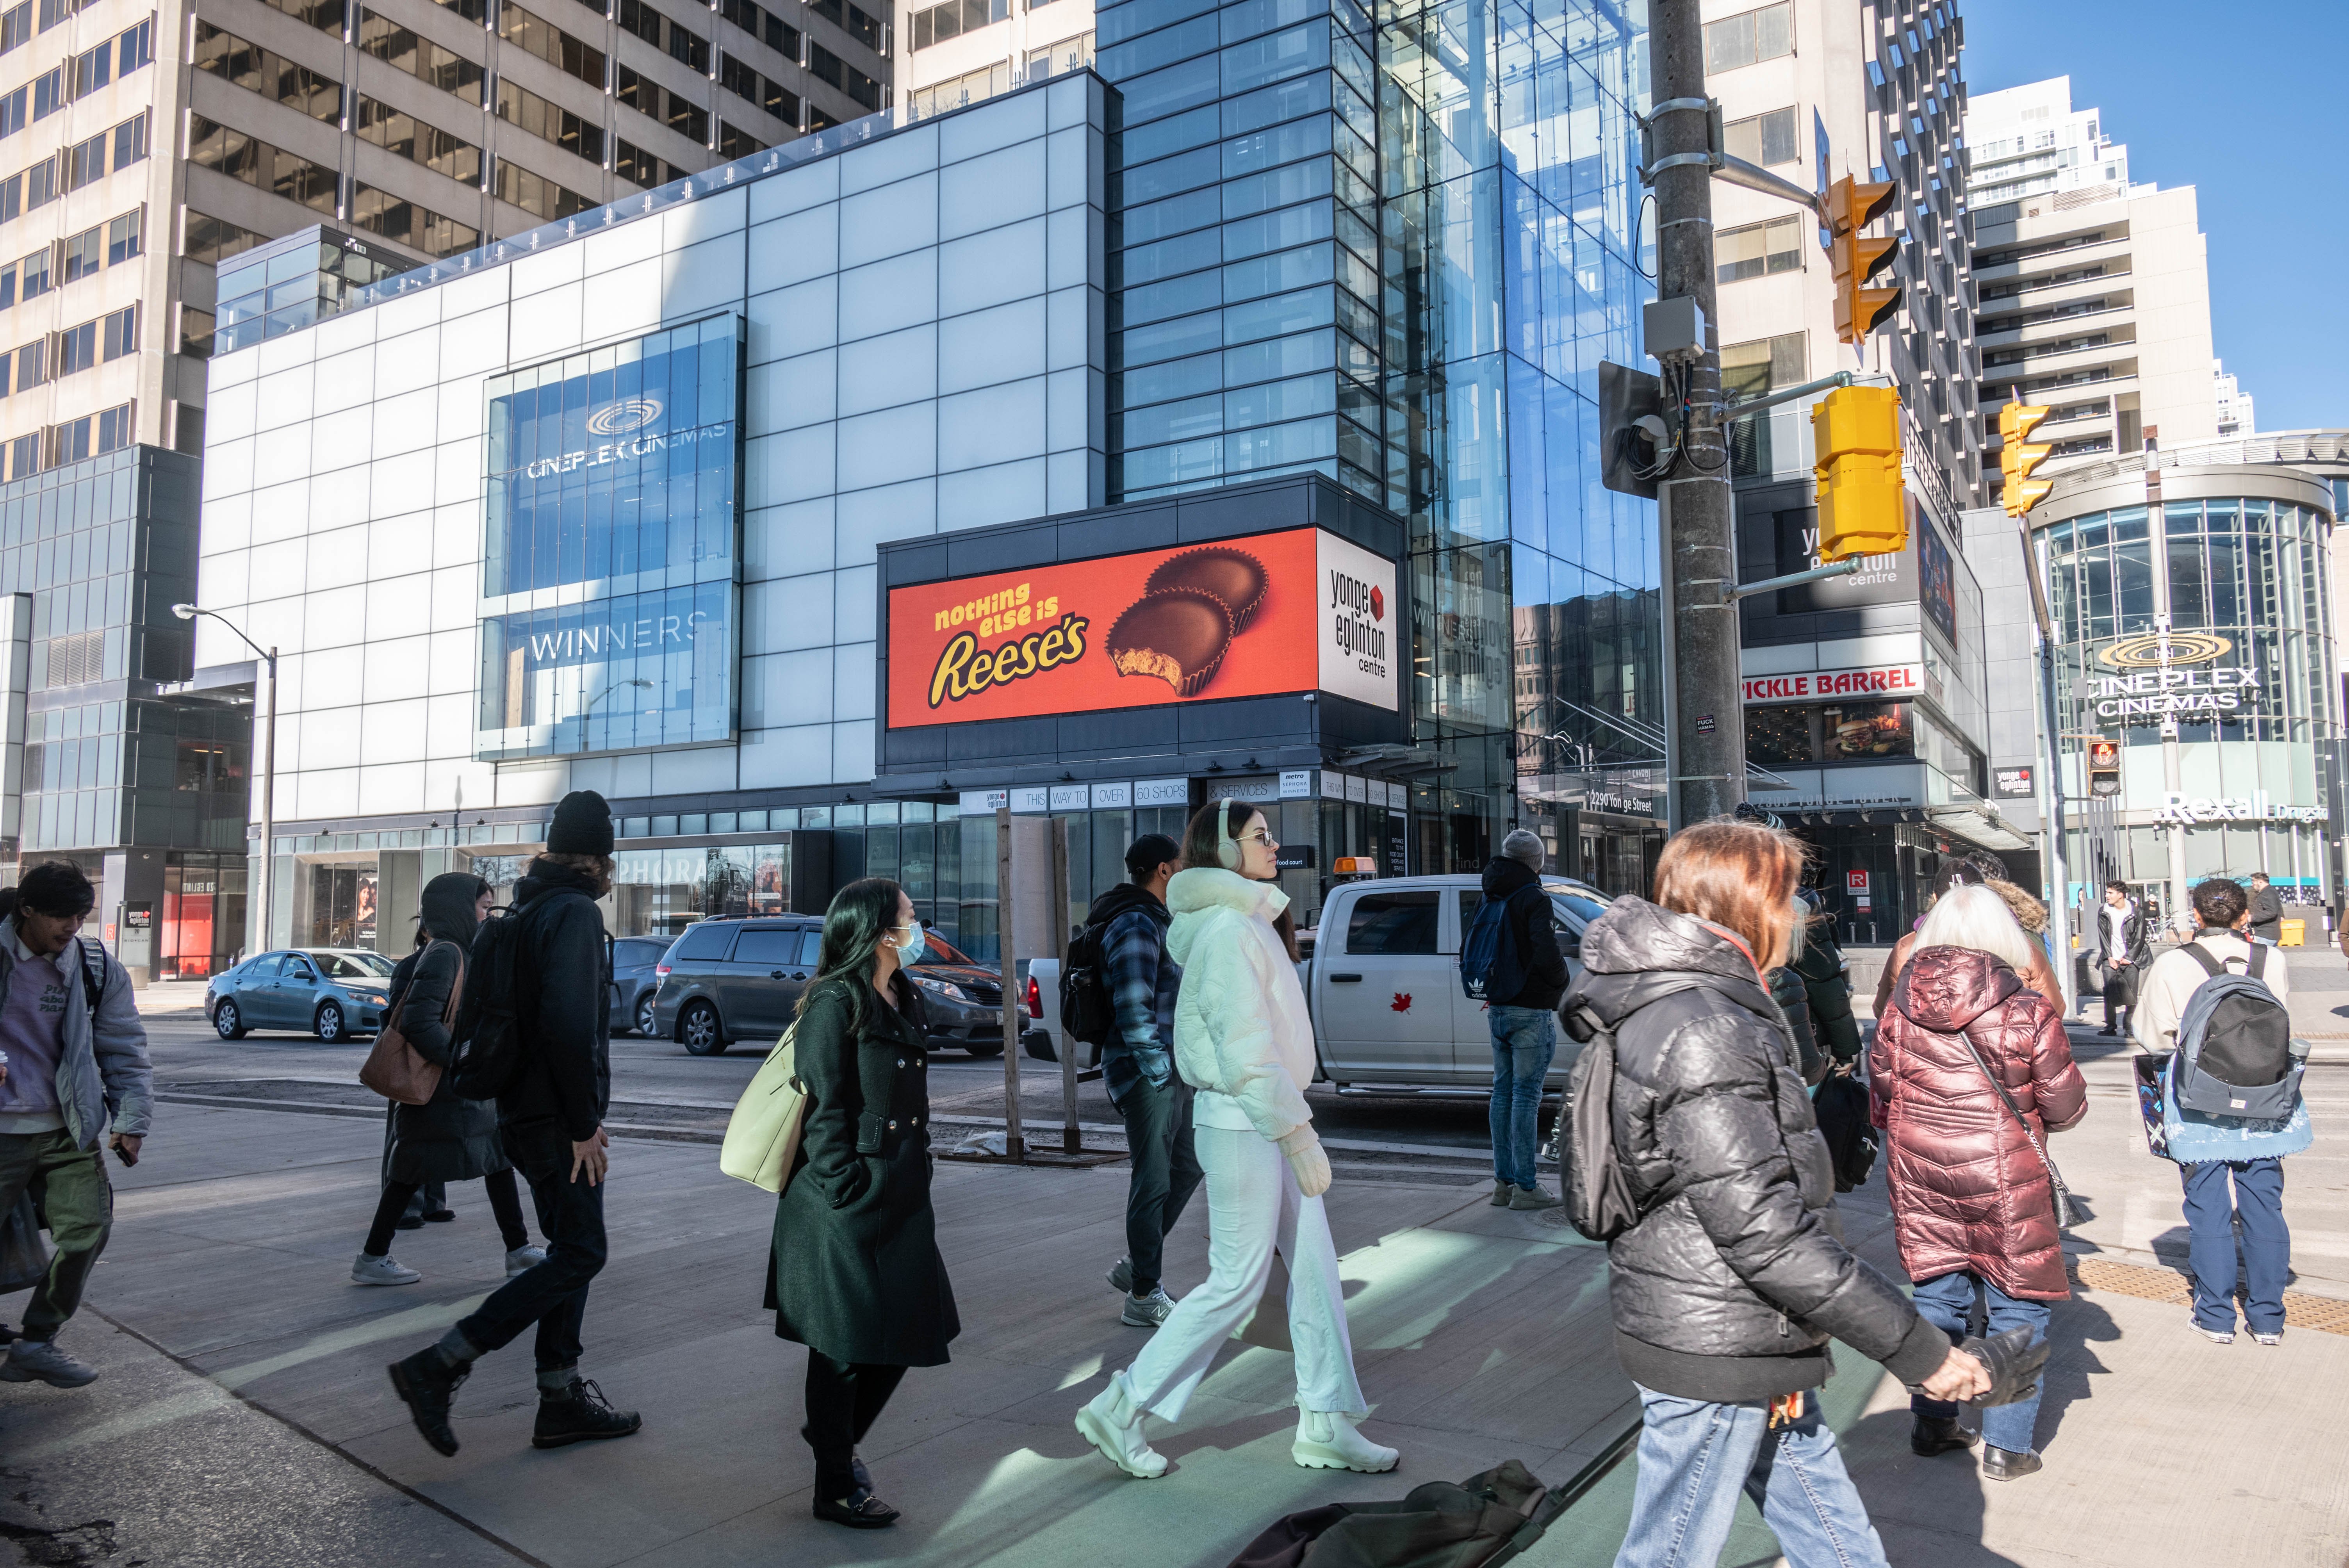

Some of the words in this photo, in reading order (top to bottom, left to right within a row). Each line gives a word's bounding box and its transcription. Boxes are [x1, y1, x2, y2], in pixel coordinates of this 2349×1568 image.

[1848, 571, 1897, 586] centre
[1331, 569, 1368, 618] yonge
[979, 605, 1031, 638] else
[1036, 596, 1058, 621] is
[531, 611, 707, 661] WINNERS
[1336, 611, 1385, 661] eglinton
[930, 616, 1086, 706] Reese's
[1359, 658, 1386, 678] centre
[1742, 677, 1809, 699] ICKLE
[1816, 669, 1916, 695] BARREL
[2087, 667, 2261, 698] CINEPLEX
[2097, 692, 2239, 717] CINEMAS
[1997, 772, 2020, 782] yonge
[2000, 780, 2030, 791] eglinton
[987, 793, 1000, 802] yonge
[988, 800, 1005, 809] eglinton
[1026, 793, 1045, 806] THIS
[1053, 792, 1071, 804] WAY
[1075, 791, 1087, 803] TO
[1099, 789, 1124, 802] OVER
[1137, 787, 1150, 800] 60
[1153, 784, 1186, 799] SHOPS
[1210, 786, 1217, 798] &
[1221, 782, 1267, 798] SERVICES
[1326, 782, 1334, 792] THIS
[1335, 783, 1343, 794] WAY
[1347, 785, 1353, 796] TO
[1353, 786, 1363, 797] OVER
[1368, 789, 1373, 799] 60
[1374, 791, 1386, 801] SHOPS
[1392, 793, 1406, 805] SERVICES
[1591, 791, 1608, 806] 2290
[1633, 797, 1652, 813] Street
[1757, 796, 1789, 808] 2300
[1798, 793, 1843, 806] YONGE
[2163, 789, 2268, 824] Rexall
[2275, 804, 2328, 823] Drugsto
[619, 858, 708, 884] PHORA
[1852, 874, 1864, 885] R
[107, 928, 114, 939] R
